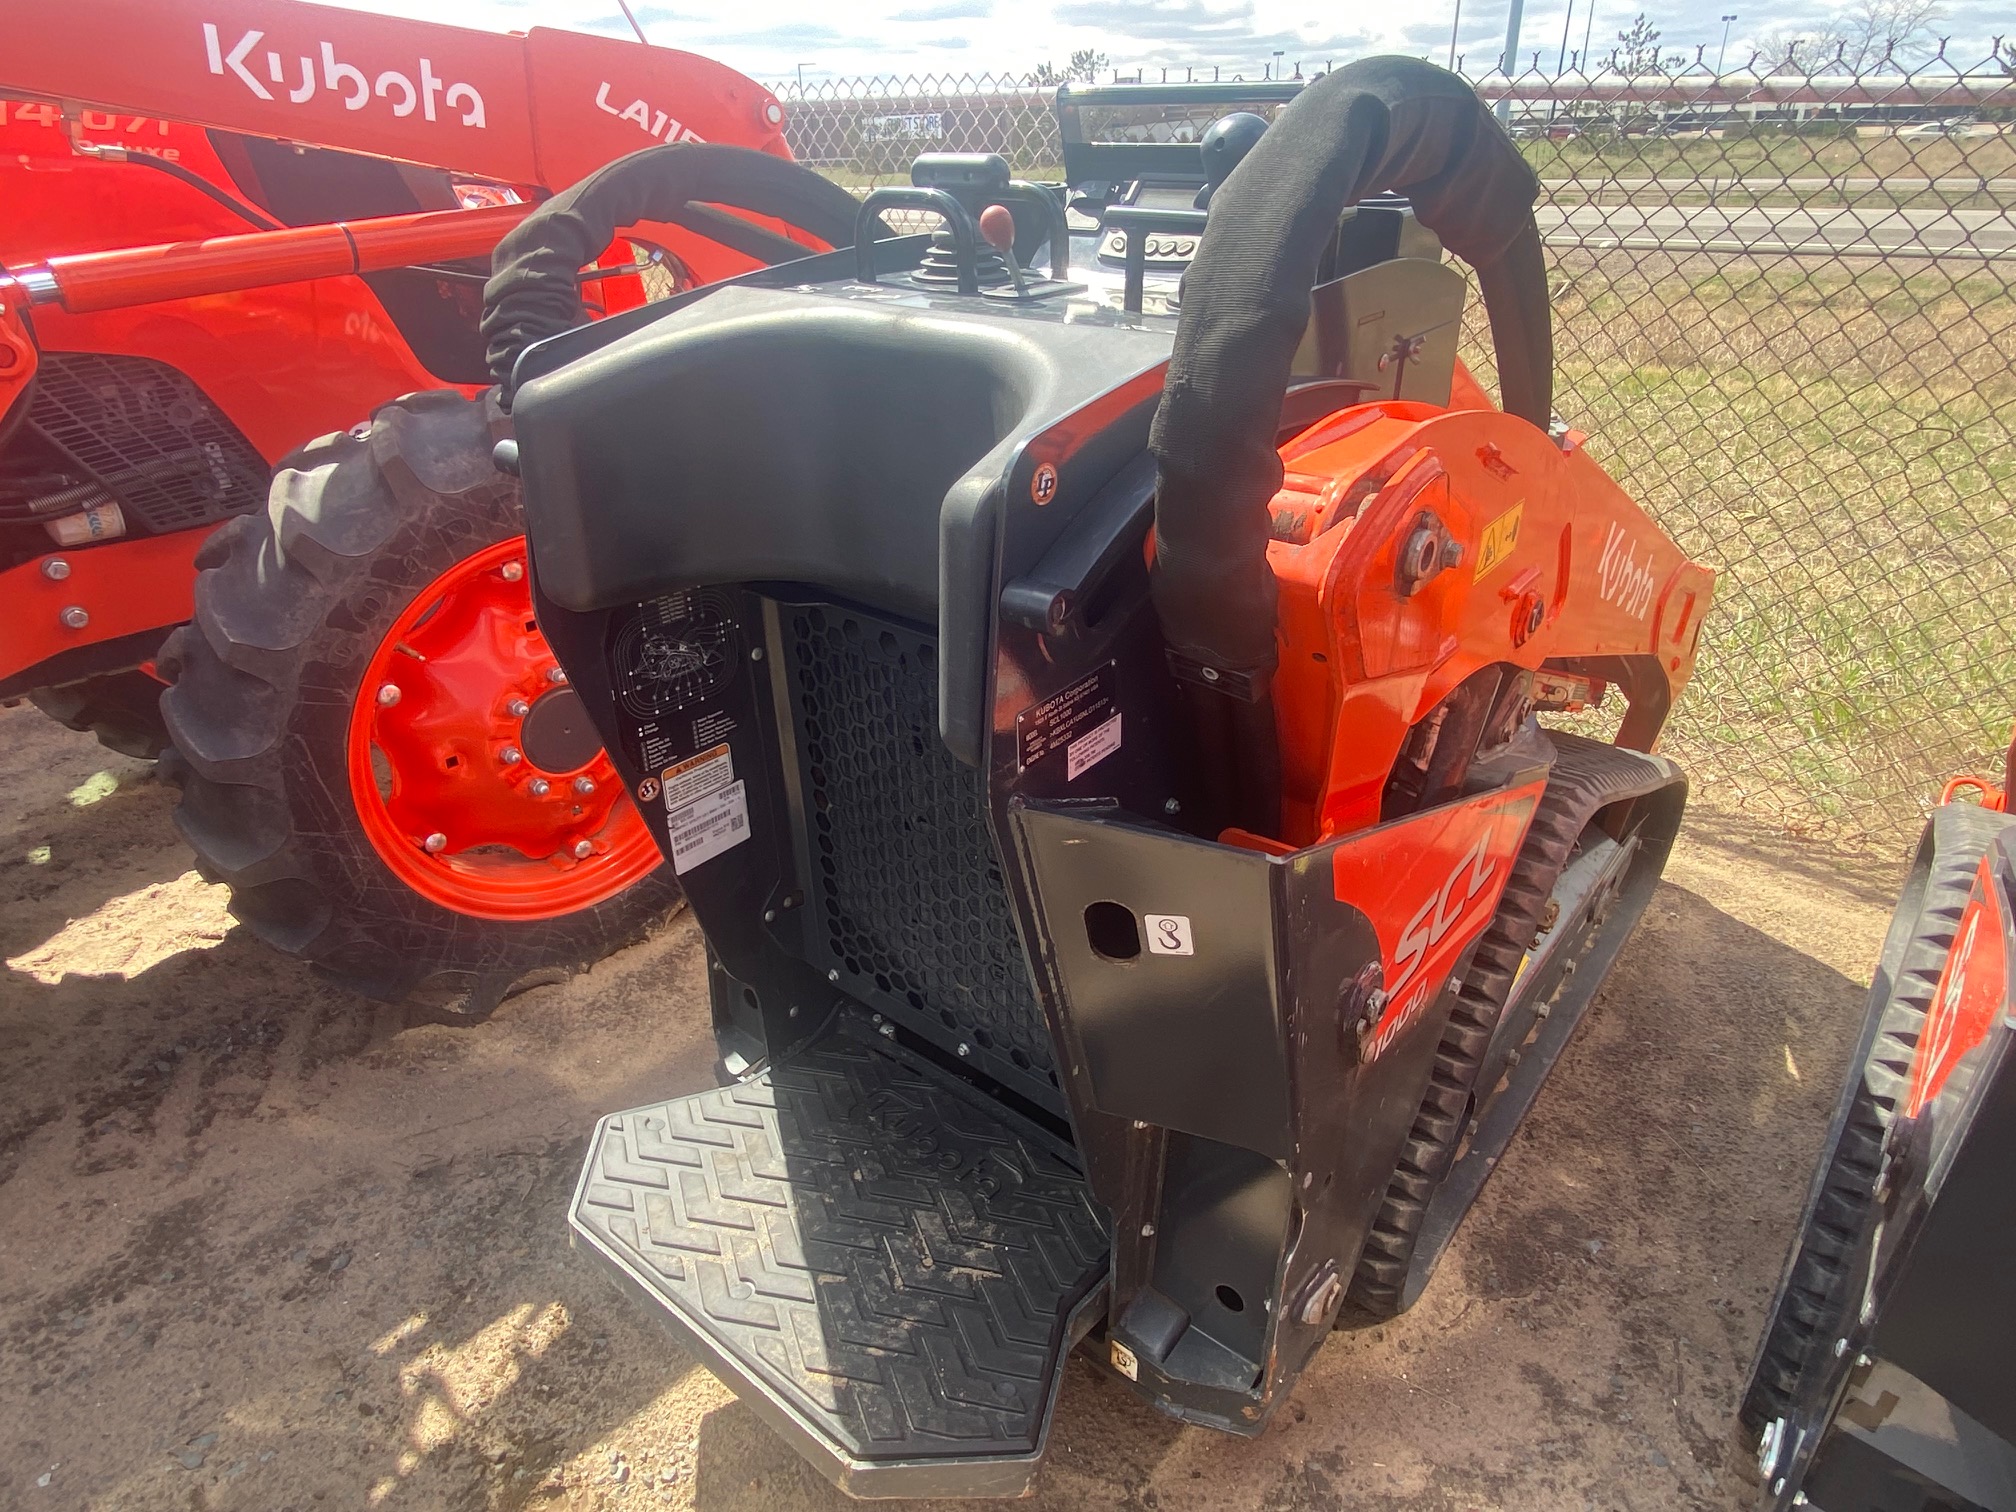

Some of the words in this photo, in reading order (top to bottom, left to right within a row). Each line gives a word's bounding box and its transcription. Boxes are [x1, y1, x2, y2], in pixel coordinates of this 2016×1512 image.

[203, 22, 486, 128] Kubota
[1598, 520, 1654, 621] Kubota
[1035, 695, 1064, 718] KUBOTA
[1064, 675, 1099, 700] Corporation
[683, 749, 718, 769] WARNING
[1384, 824, 1498, 1003] SCL
